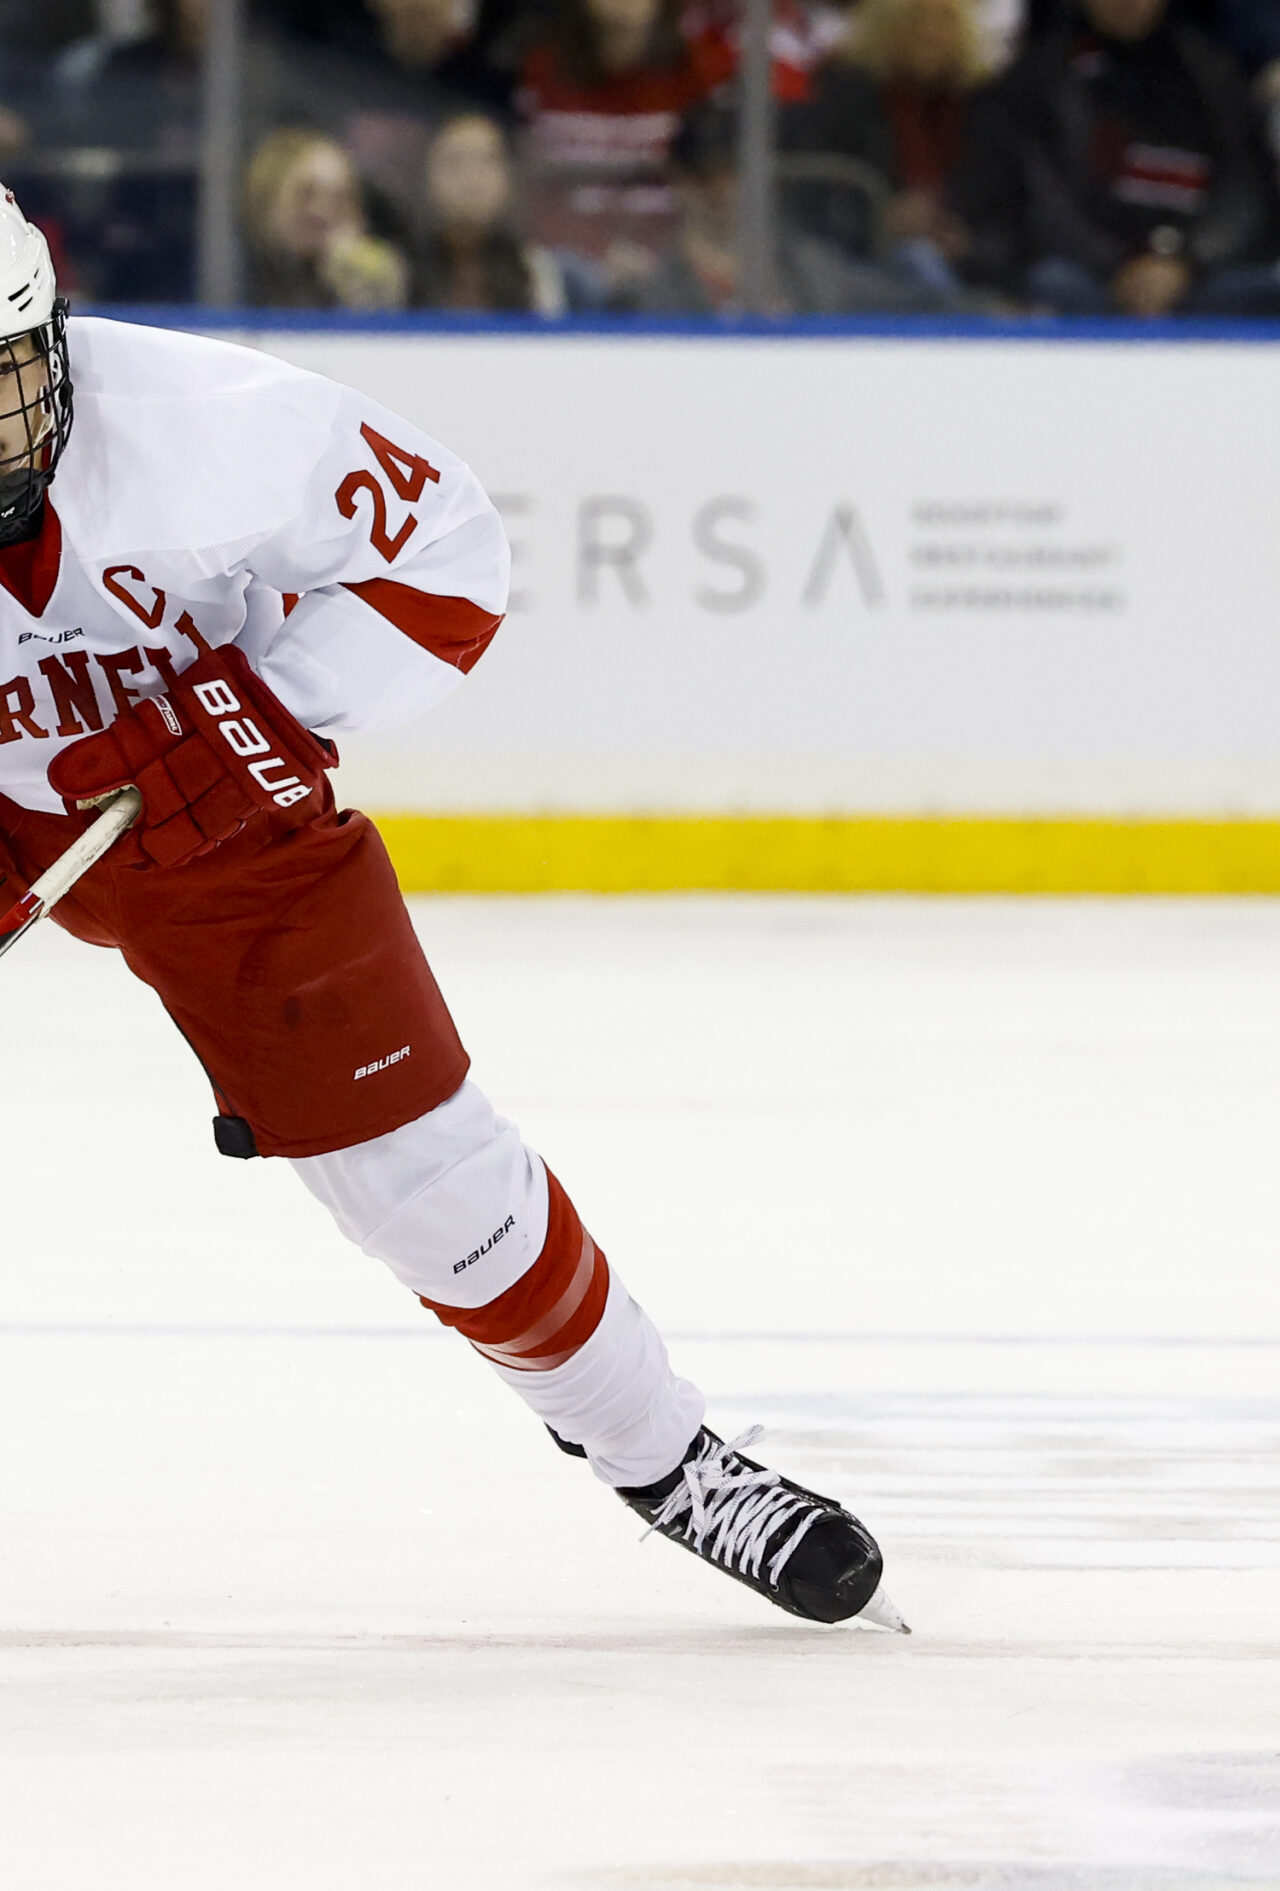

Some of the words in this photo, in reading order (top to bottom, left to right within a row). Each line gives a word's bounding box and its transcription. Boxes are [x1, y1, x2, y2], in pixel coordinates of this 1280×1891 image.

[334, 421, 441, 564] 24
[102, 564, 167, 630] C
[354, 1045, 411, 1080] BAUER
[453, 1214, 516, 1275] BAUER
